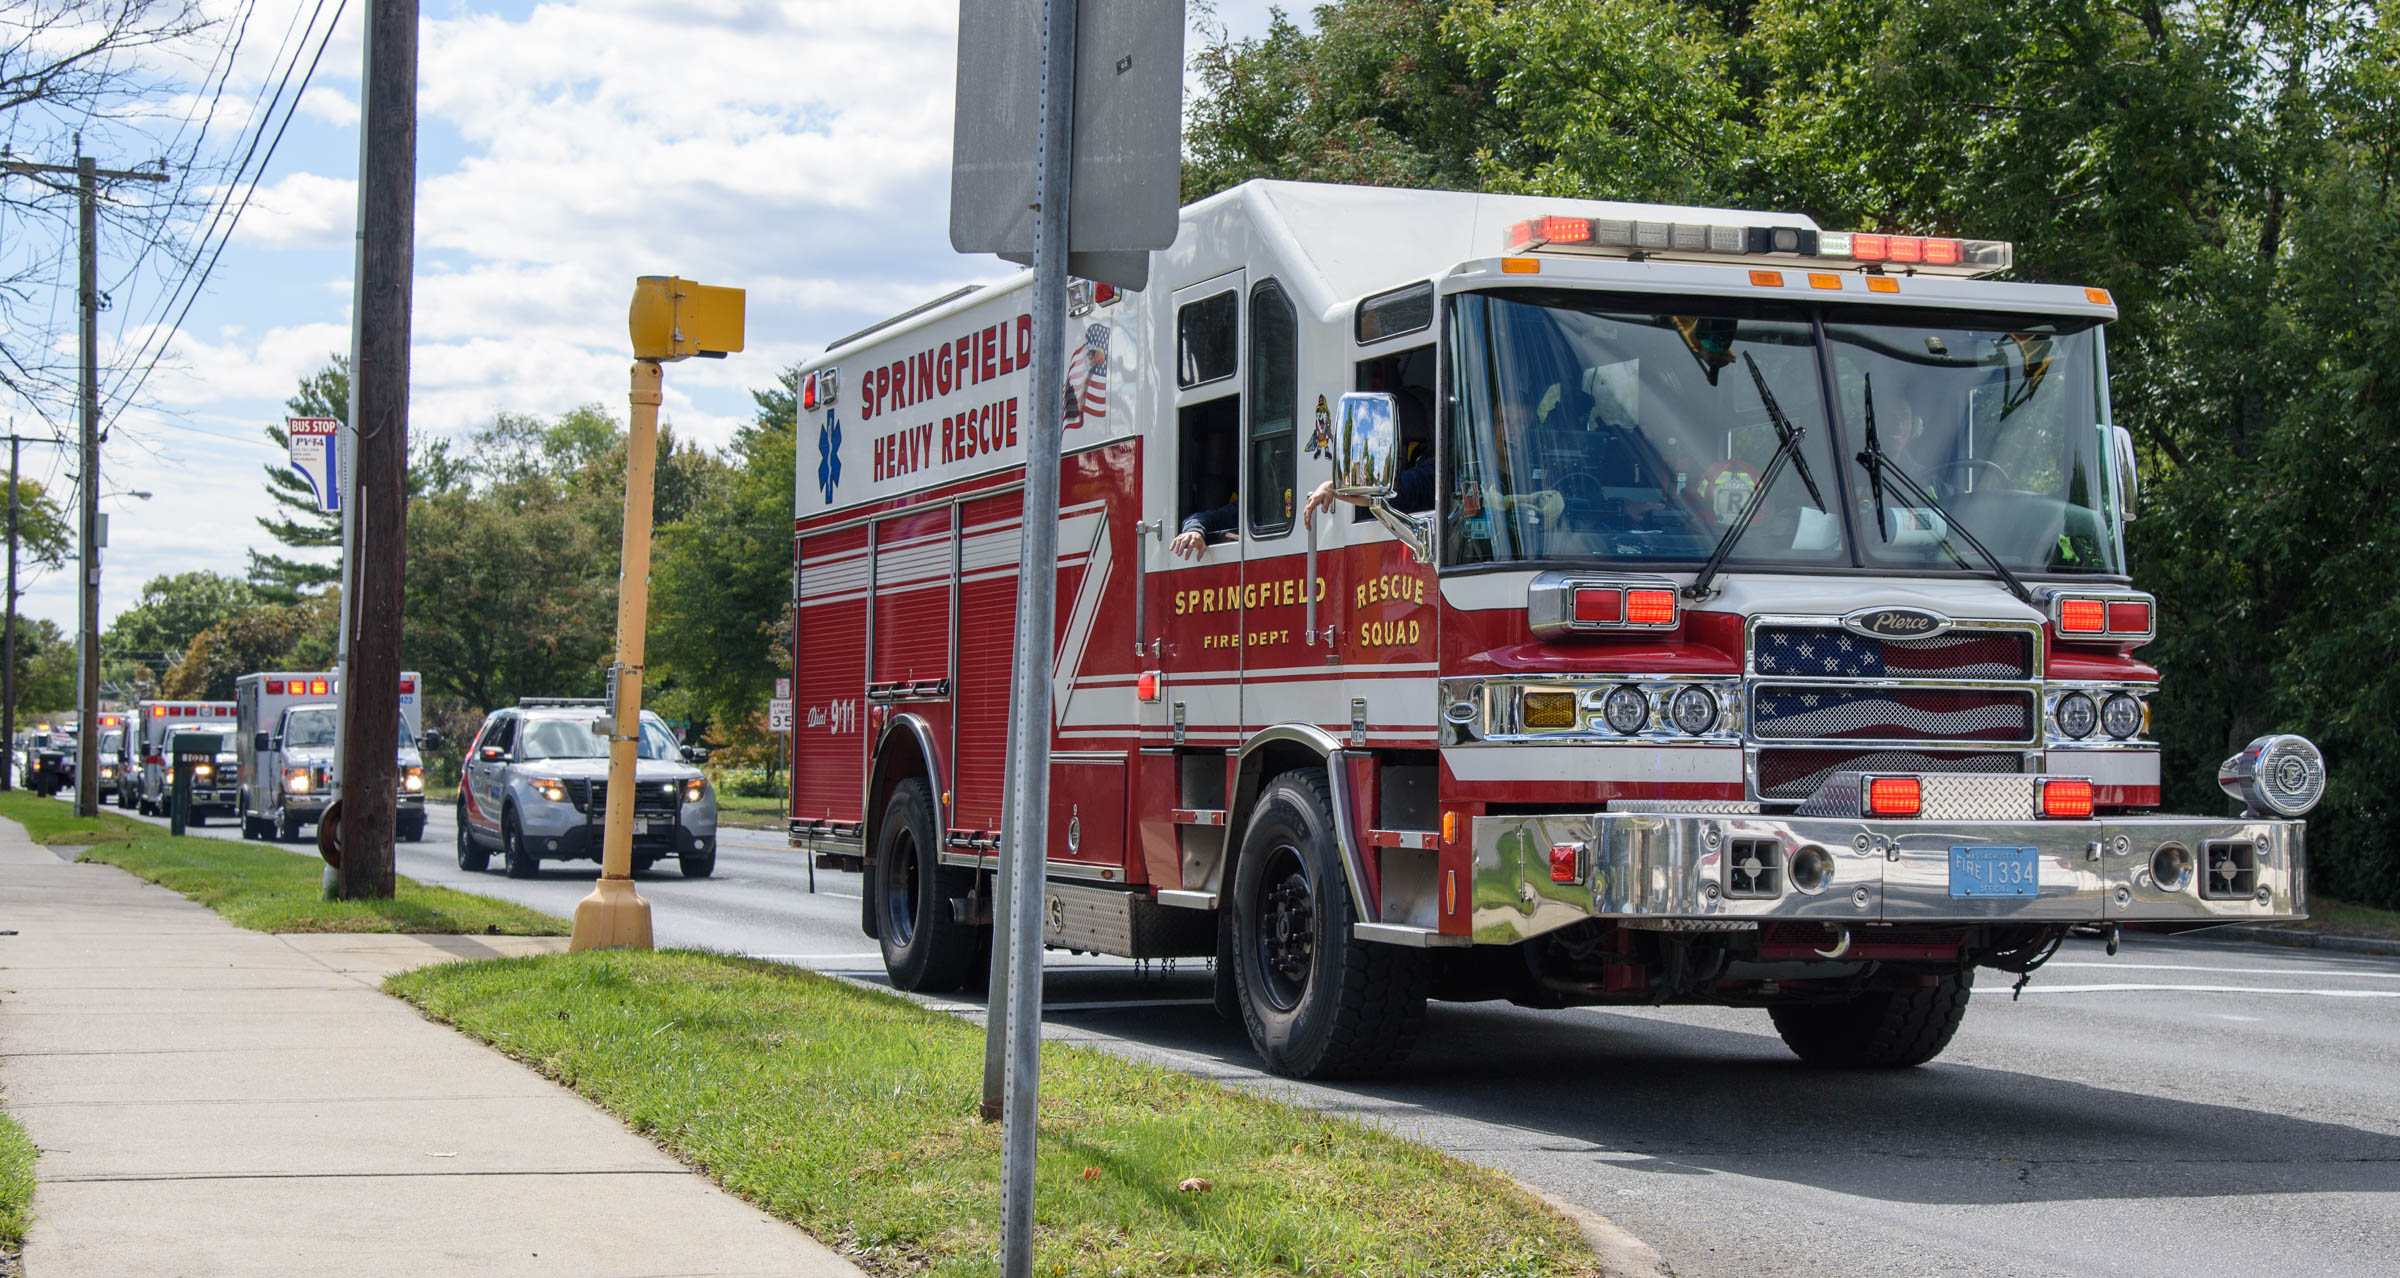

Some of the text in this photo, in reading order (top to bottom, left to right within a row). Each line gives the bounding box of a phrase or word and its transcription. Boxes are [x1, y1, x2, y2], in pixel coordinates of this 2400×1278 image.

[861, 313, 1032, 422] SPRINGFIELD
[292, 420, 336, 432] BUS STOP
[873, 397, 1018, 483] HEAVY RESCUE
[1175, 577, 1326, 616] SPRINGFIELD
[1356, 574, 1424, 610] RESCUE
[1361, 619, 1420, 647] SQUAD
[1873, 612, 1929, 632] Pierce
[1203, 634, 1240, 649] FIRE
[772, 715, 792, 728] 35
[807, 705, 827, 728] Dial
[1955, 854, 2034, 885] FIRE 1334
